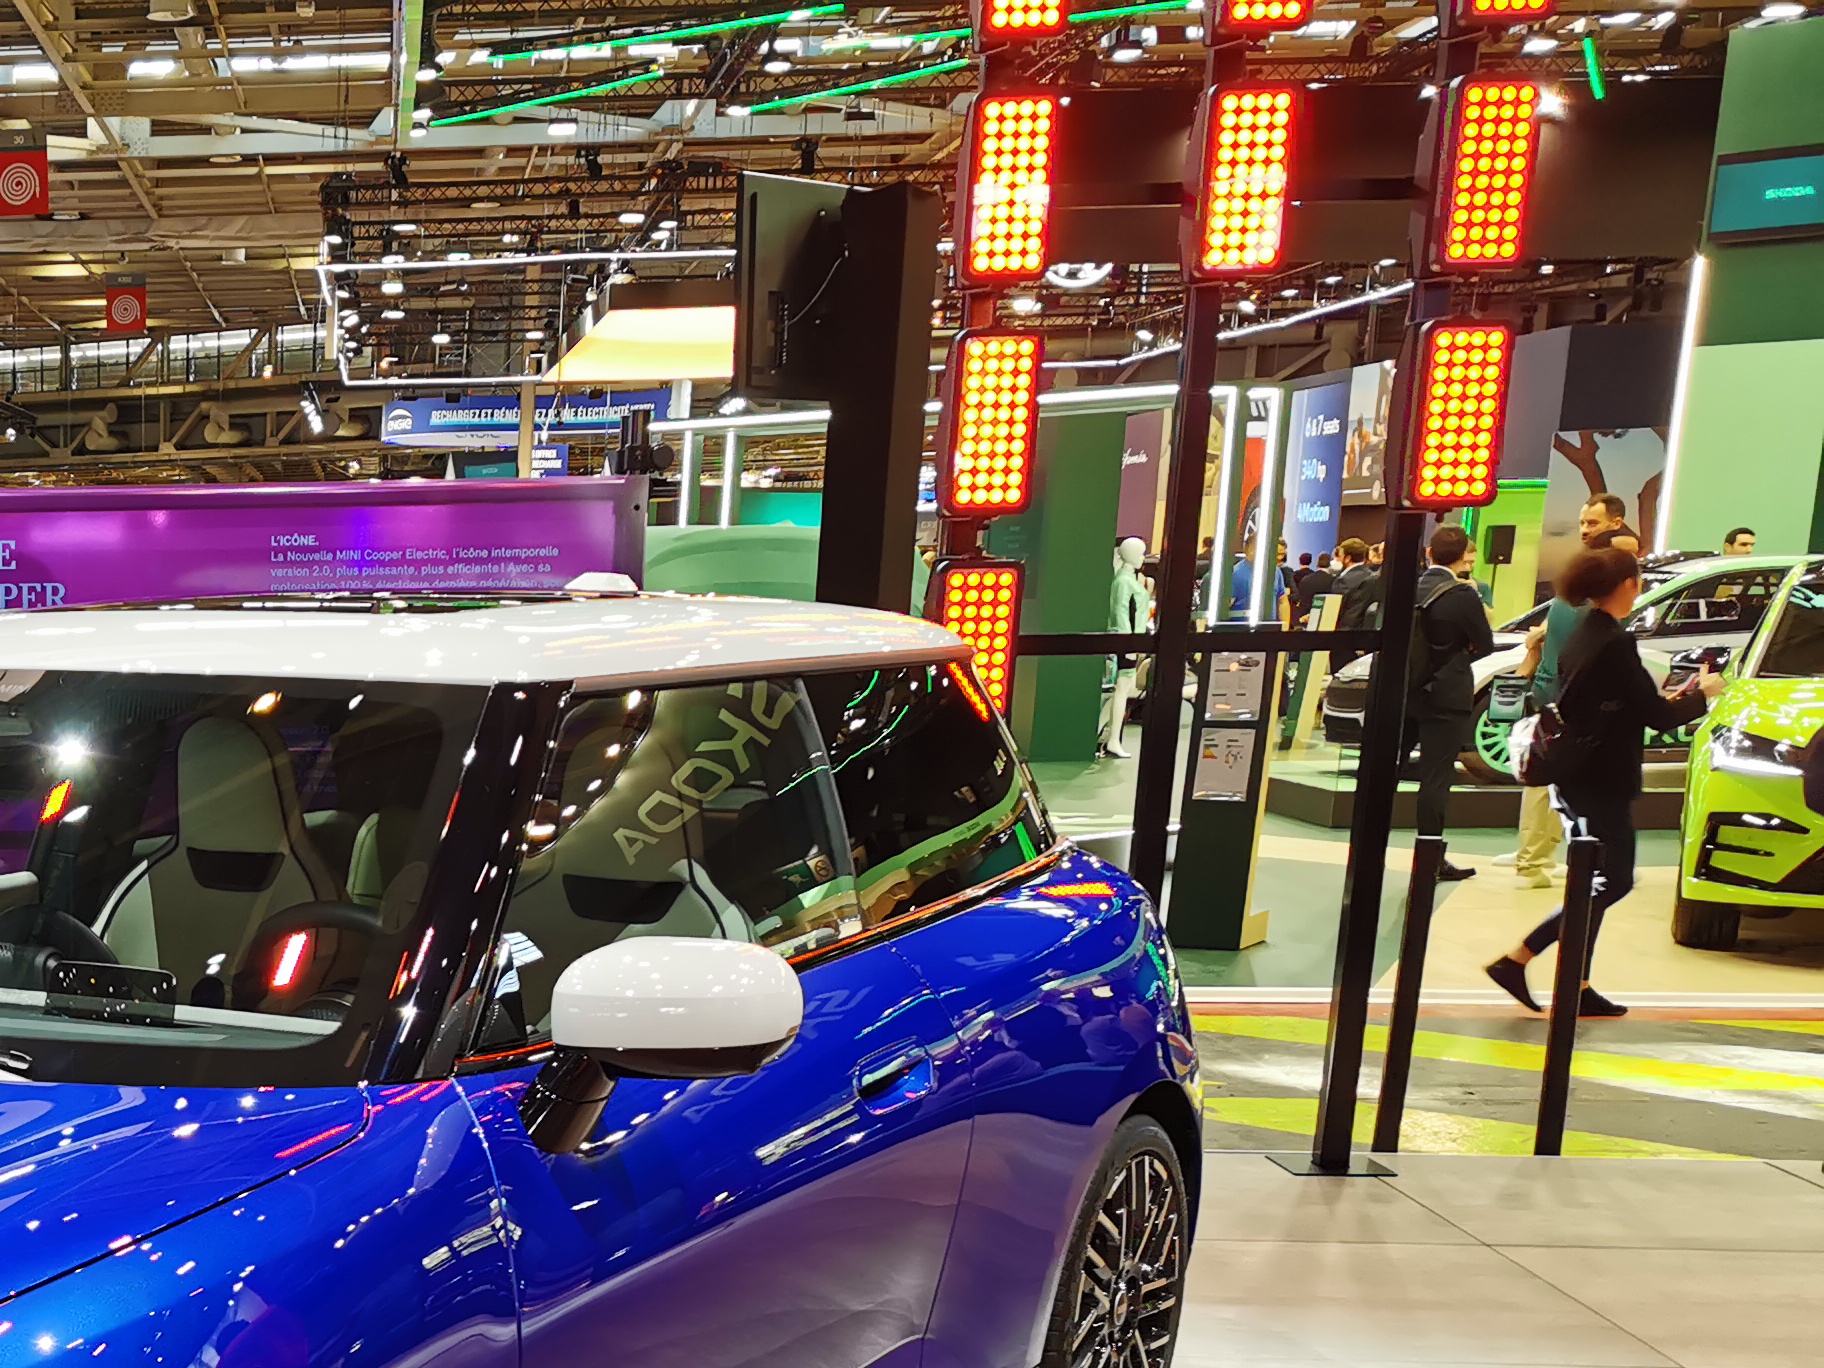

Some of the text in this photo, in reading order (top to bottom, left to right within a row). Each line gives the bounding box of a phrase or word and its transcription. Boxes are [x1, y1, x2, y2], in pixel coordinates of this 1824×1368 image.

[431, 409, 480, 423] RECHARGEZ
[481, 408, 493, 421] ET
[270, 532, 320, 547] L'ICÔNE.
[270, 551, 285, 562] La
[286, 550, 334, 562] Nouvelle
[335, 549, 362, 561] MINI
[364, 549, 404, 562] Cooper
[405, 547, 450, 561] Electric,
[491, 545, 560, 562] intemporelle
[270, 566, 310, 577] version
[312, 565, 334, 578] 2.0,
[336, 565, 359, 579] plus
[362, 563, 418, 577] puissante,
[421, 562, 445, 576] plus
